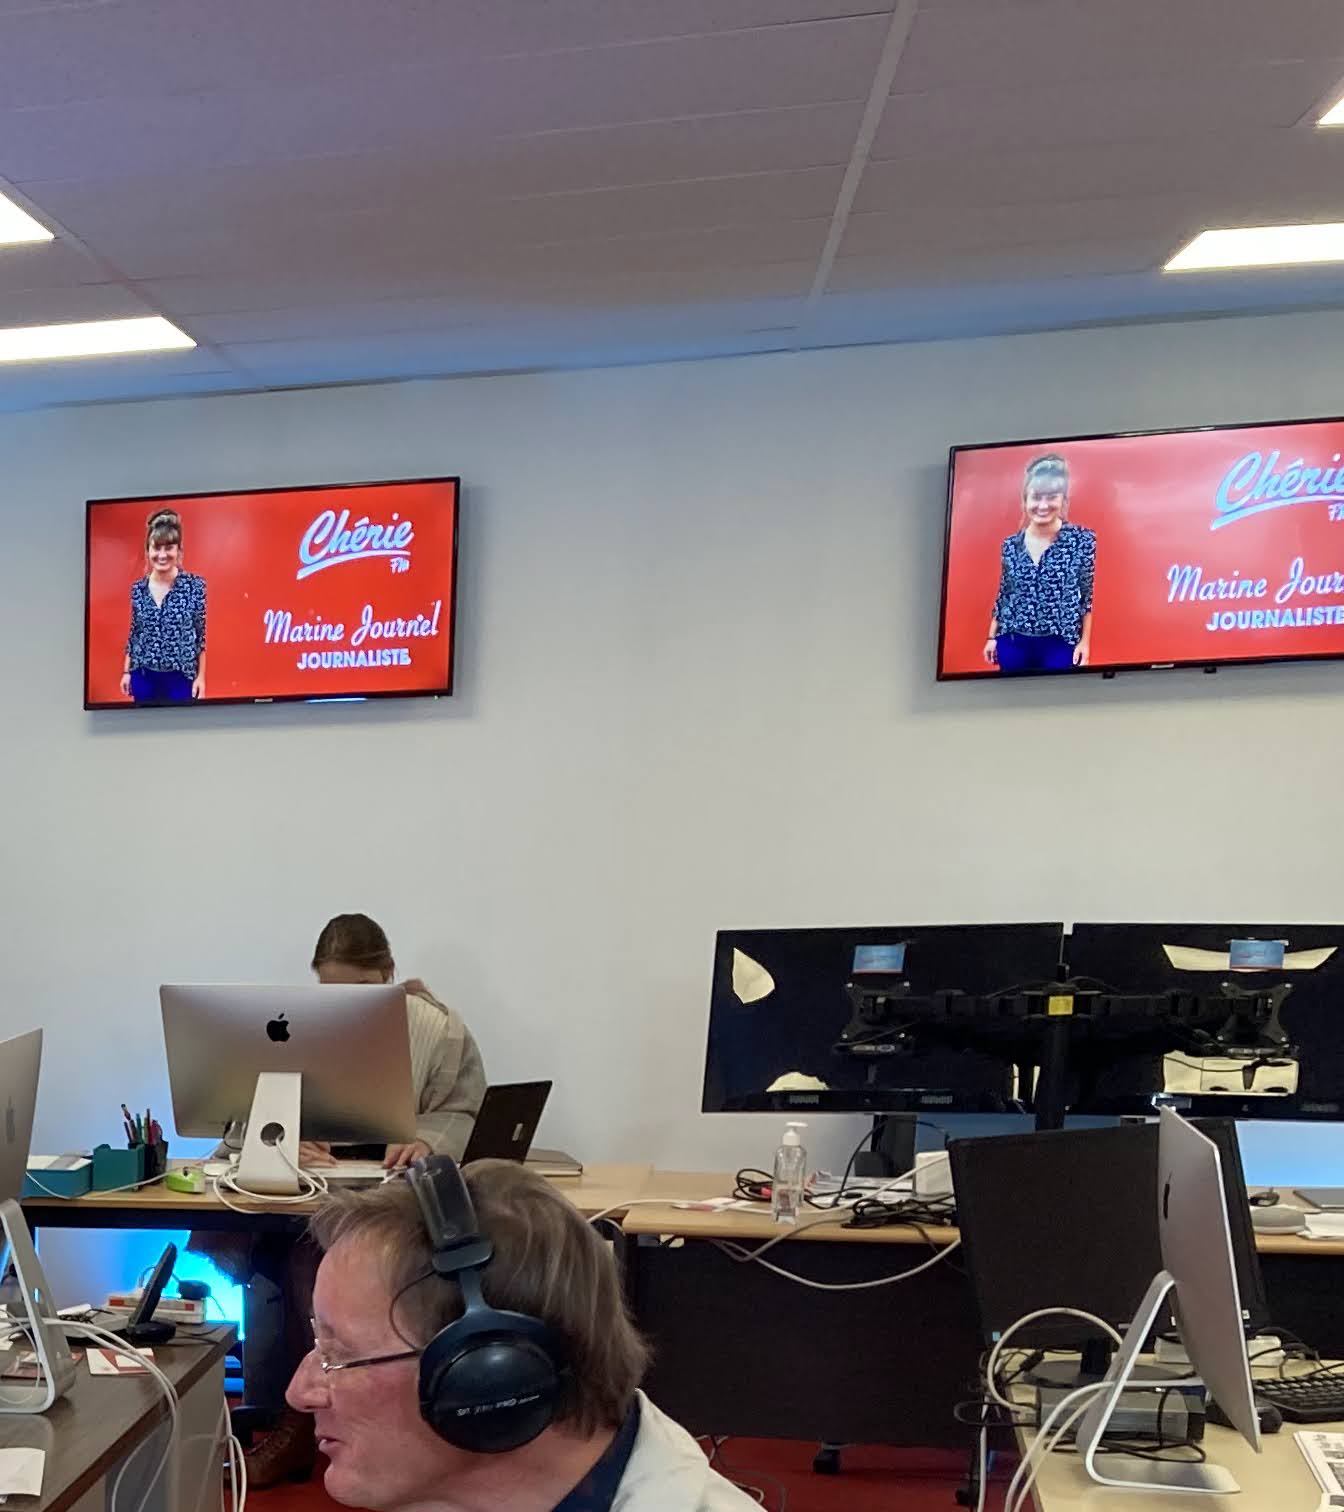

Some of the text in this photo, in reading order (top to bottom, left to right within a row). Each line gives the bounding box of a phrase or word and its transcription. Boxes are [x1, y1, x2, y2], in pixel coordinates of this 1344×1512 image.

[299, 509, 414, 566] Chérie
[1167, 556, 1344, 604] Marine Jour
[263, 609, 344, 643] Marine
[297, 648, 411, 670] JOURNALISTE
